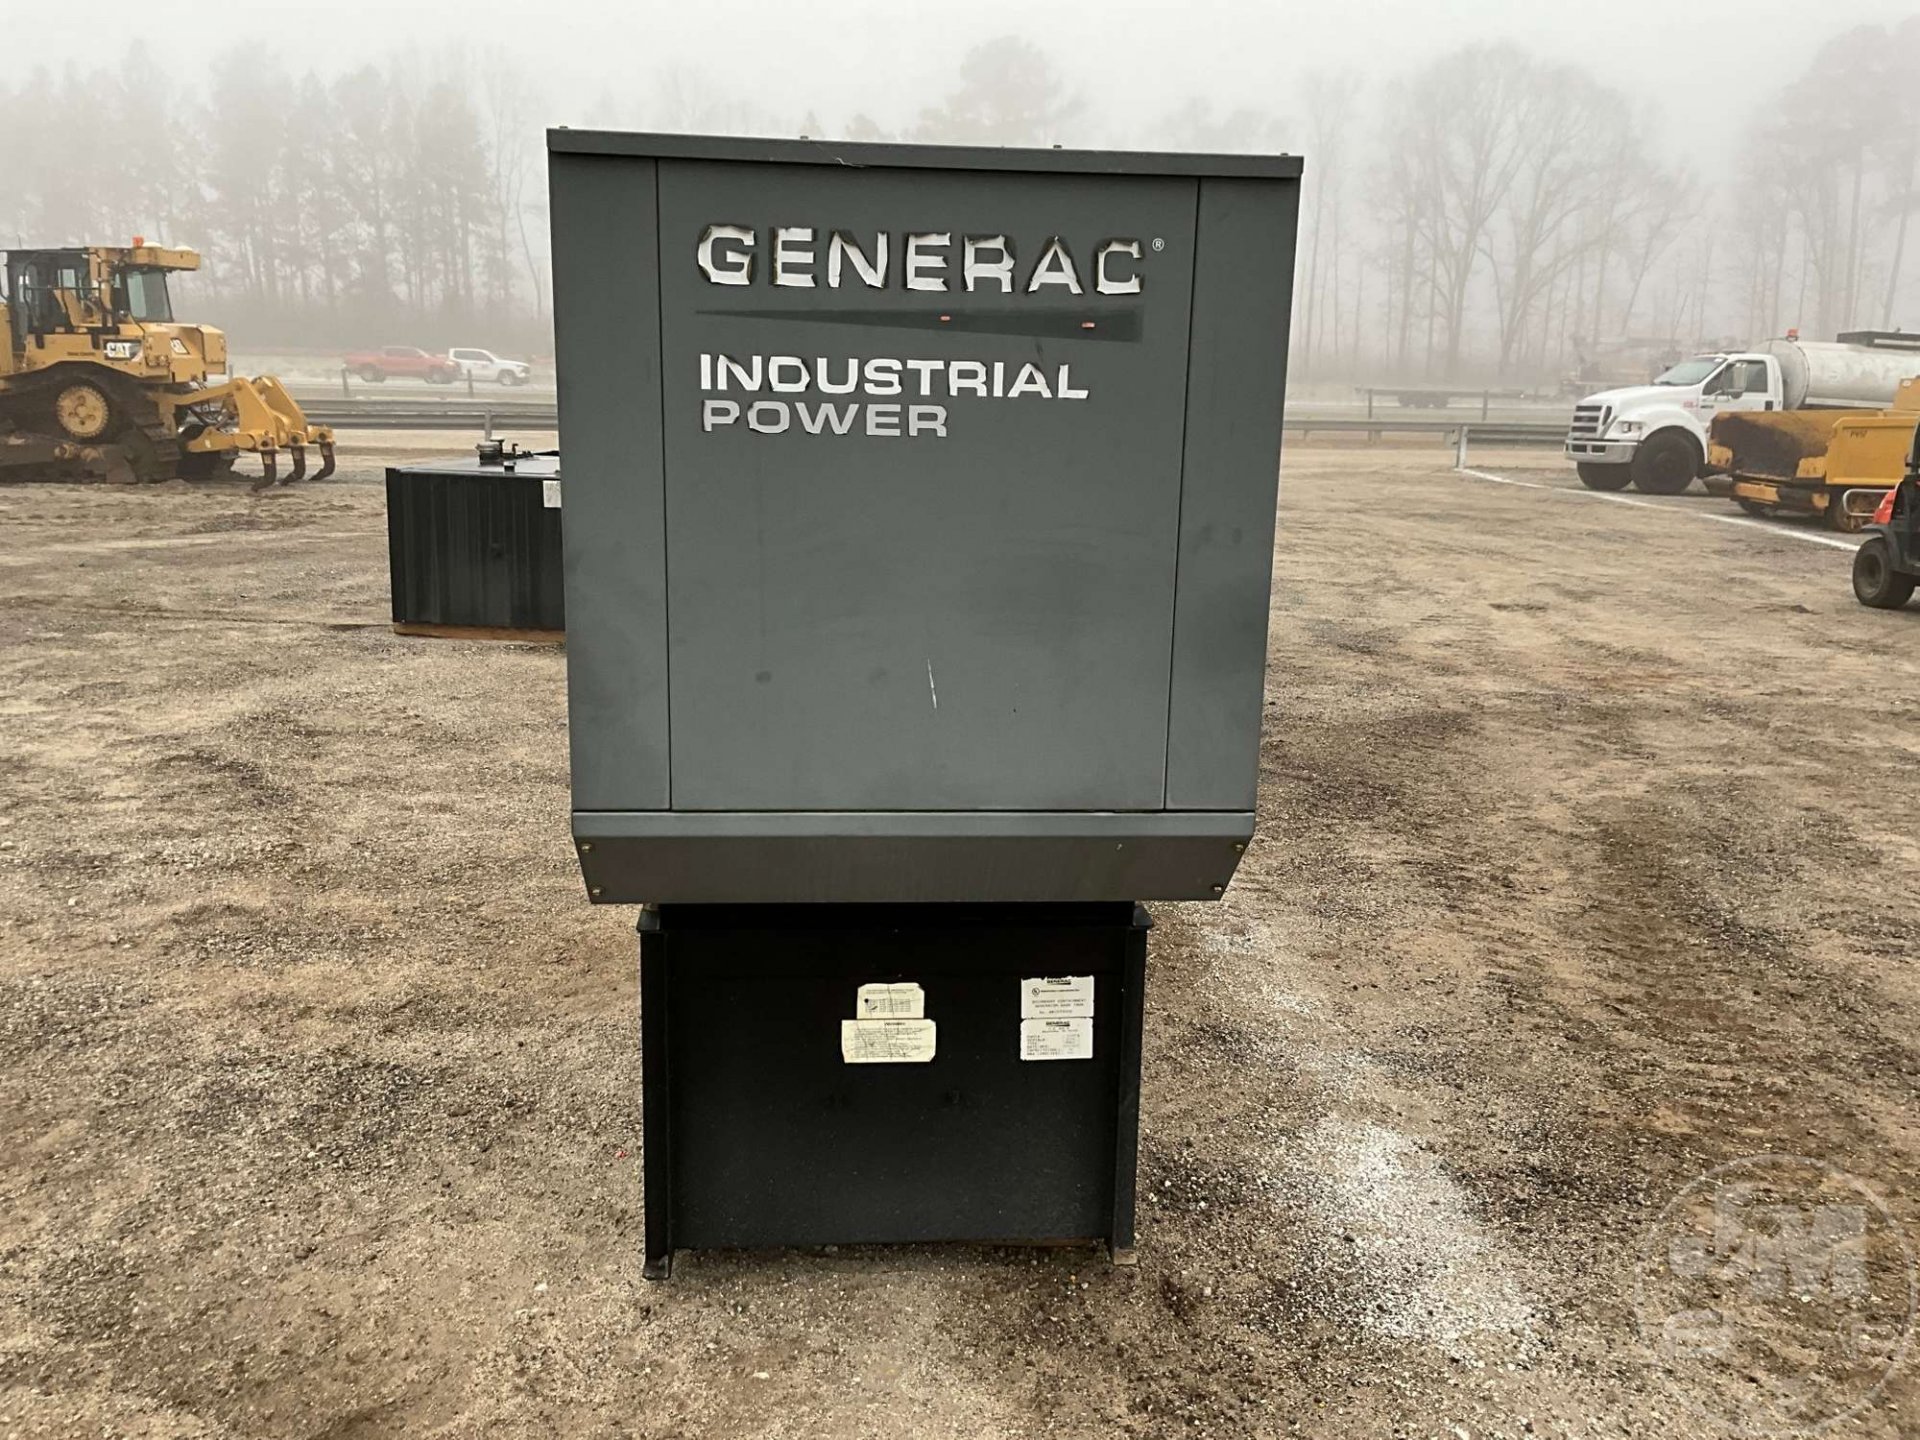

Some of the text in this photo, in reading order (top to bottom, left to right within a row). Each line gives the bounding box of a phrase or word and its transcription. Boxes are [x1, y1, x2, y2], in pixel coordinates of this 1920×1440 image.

[104, 342, 131, 358] CAT
[699, 353, 1090, 400] INDUSTRIAL
[701, 399, 949, 438] POWER
